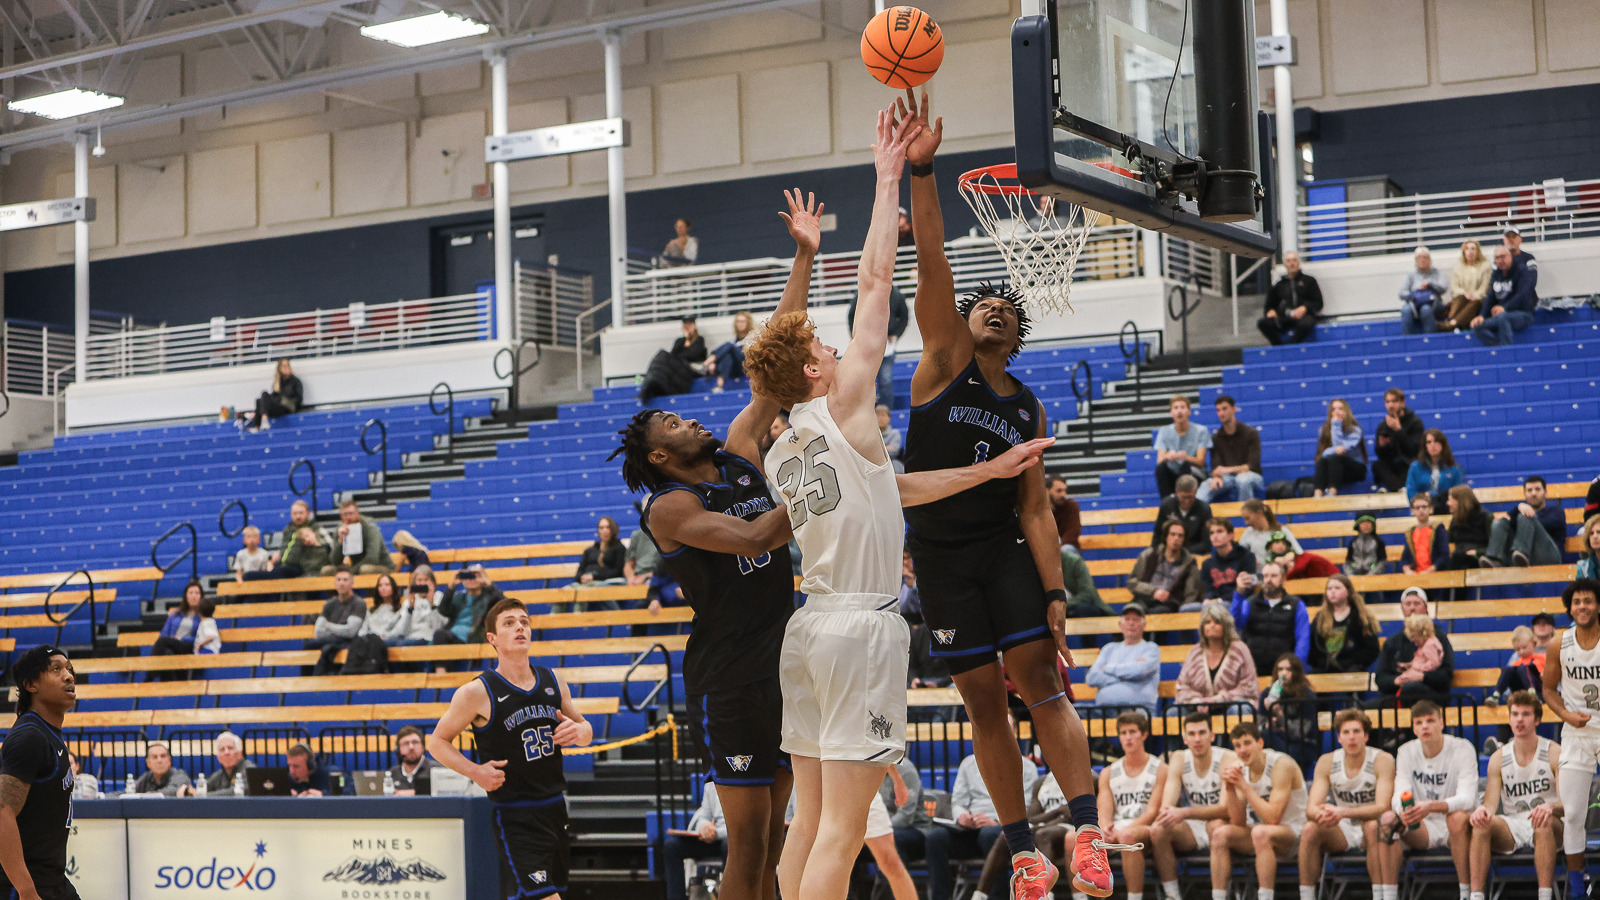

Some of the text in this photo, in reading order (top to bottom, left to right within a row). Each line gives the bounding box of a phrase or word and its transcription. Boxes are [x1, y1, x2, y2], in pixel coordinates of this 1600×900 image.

[948, 406, 1025, 447] WILLIAM
[777, 434, 841, 531] 25
[1565, 665, 1600, 680] MINE
[503, 704, 561, 731] WILLIAM
[521, 725, 555, 762] 25
[1505, 777, 1550, 798] MINES
[352, 838, 413, 850] MINES
[154, 856, 276, 891] sodexo
[341, 890, 431, 900] BOOKSTORE
